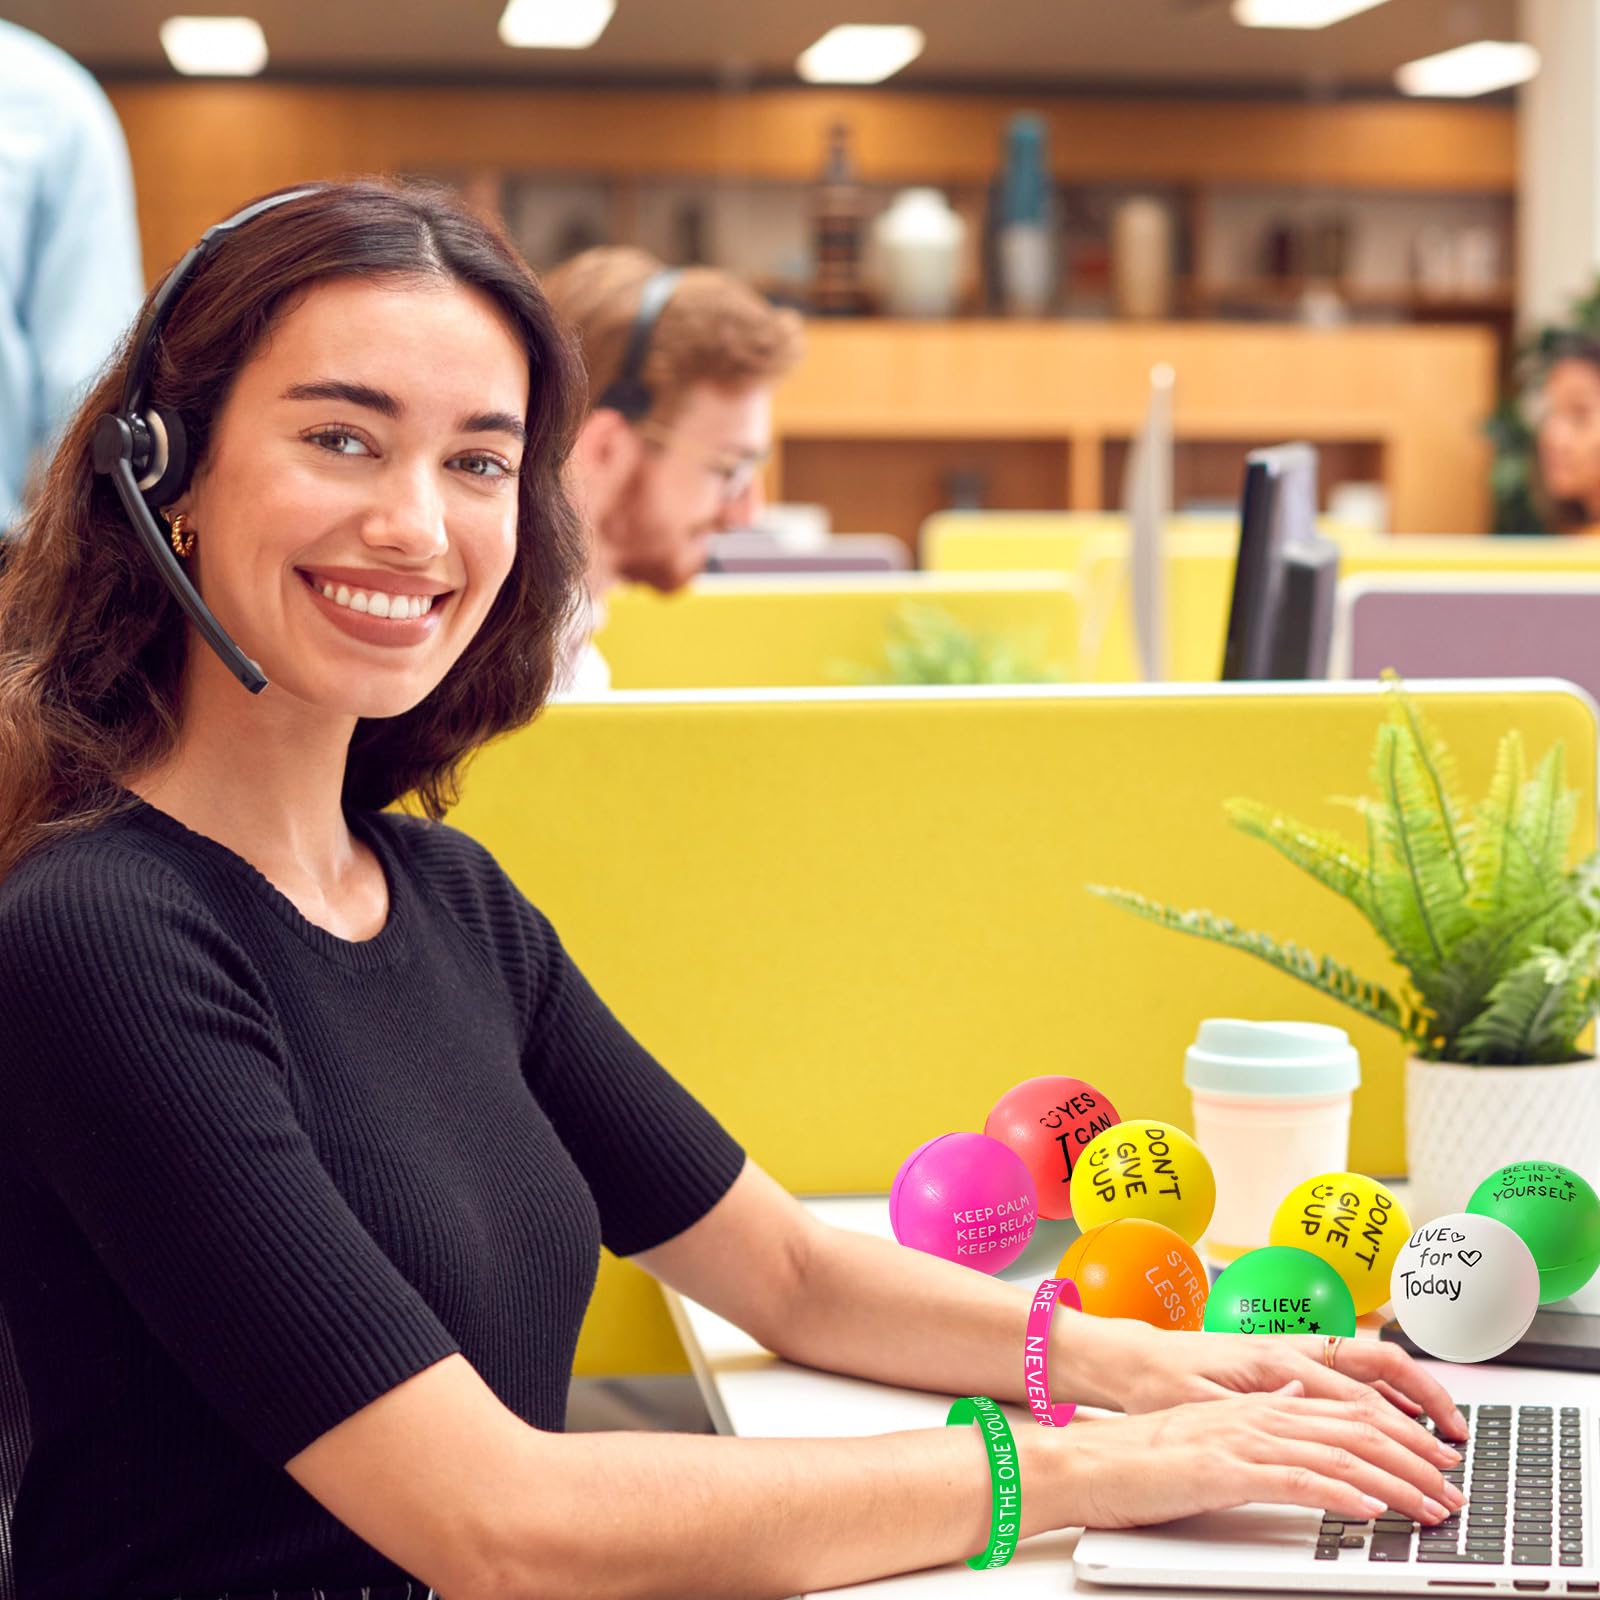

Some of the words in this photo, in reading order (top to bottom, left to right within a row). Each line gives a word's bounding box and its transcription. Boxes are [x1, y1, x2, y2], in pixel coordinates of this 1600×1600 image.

[1056, 1092, 1096, 1120] YES
[1055, 1132, 1074, 1184] I
[1074, 1112, 1112, 1145] CAN
[1117, 1142, 1147, 1199] GIVE
[1145, 1129, 1182, 1201] DON'T
[1503, 1164, 1567, 1175] BELIEVE
[1092, 1168, 1116, 1203] UP
[1493, 1186, 1577, 1203] YOURSELF
[953, 1207, 994, 1225] KEEP
[996, 1194, 1030, 1217] CALM
[1301, 1204, 1326, 1236] UP
[1326, 1192, 1361, 1249] GIVE
[956, 1225, 997, 1241] KEEP
[999, 1210, 1036, 1235] RELAX
[957, 1241, 998, 1256] KEEP
[999, 1226, 1034, 1249] SMILE
[1355, 1193, 1393, 1271] DON'T
[1420, 1247, 1453, 1268] for
[1145, 1266, 1186, 1322] LESS
[1400, 1270, 1462, 1301] Today
[1240, 1298, 1312, 1313] BELIEVE
[1025, 1336, 1047, 1410] NEVER
[982, 1413, 1008, 1441] YOU
[993, 1443, 1016, 1480] ONE
[999, 1483, 1017, 1520] THE
[997, 1523, 1016, 1537] IS
